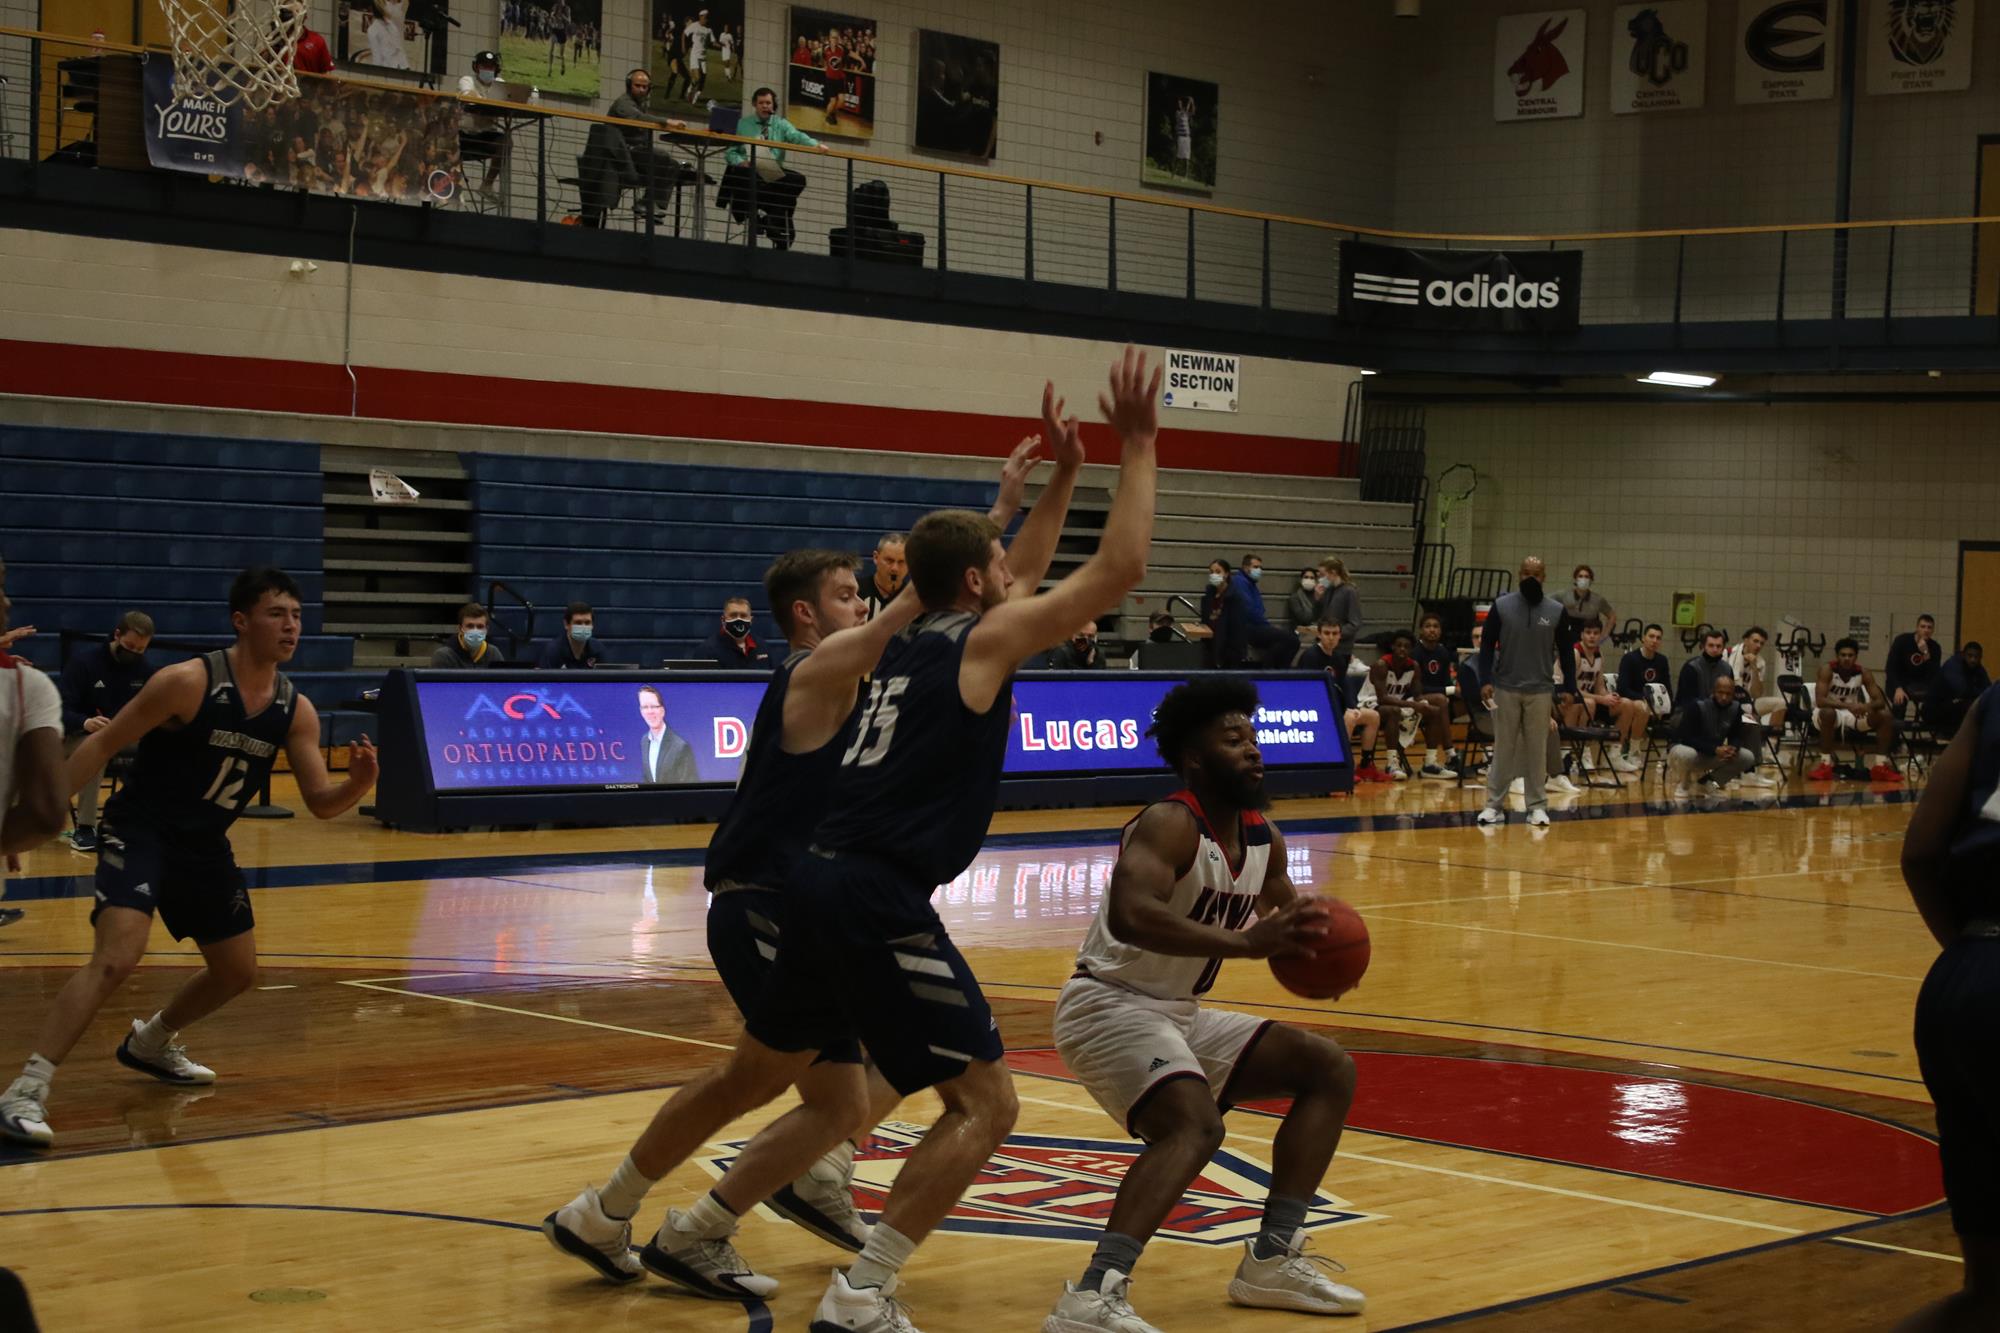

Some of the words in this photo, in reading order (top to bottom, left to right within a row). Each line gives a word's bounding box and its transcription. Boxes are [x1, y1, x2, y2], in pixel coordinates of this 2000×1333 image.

[182, 99, 215, 112] MAKE
[216, 103, 227, 114] IT
[154, 103, 228, 140] YOURS
[1426, 273, 1560, 309] adidas
[1170, 353, 1235, 373] NEWMAN
[1170, 373, 1233, 392] SECTION
[1258, 706, 1319, 726] Surgeon
[713, 716, 749, 759] D
[1020, 712, 1140, 751] Lucas
[1257, 728, 1315, 744] thletics
[443, 741, 625, 764] ORTHOPAEDIC
[200, 755, 250, 811] 12
